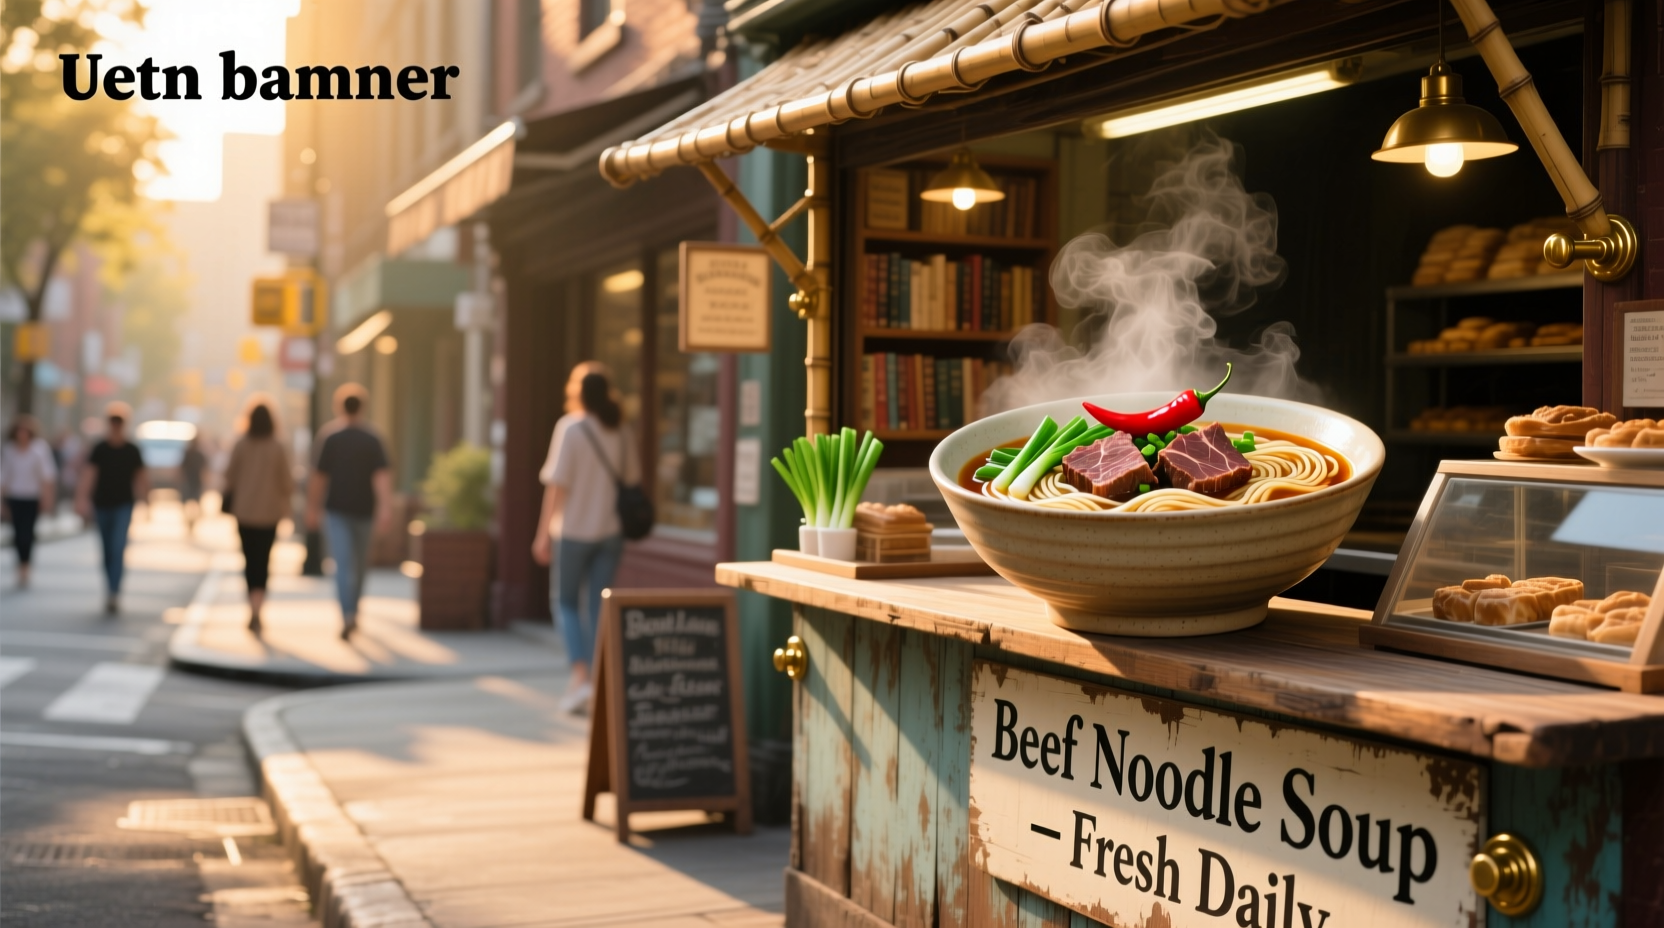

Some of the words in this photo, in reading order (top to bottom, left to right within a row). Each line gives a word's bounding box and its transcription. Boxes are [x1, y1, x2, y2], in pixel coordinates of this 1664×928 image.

[991, 698, 1084, 781] Beef
[1090, 723, 1262, 834] Noodle
[1280, 767, 1438, 905] Soup
[1070, 809, 1181, 904] Fresh
